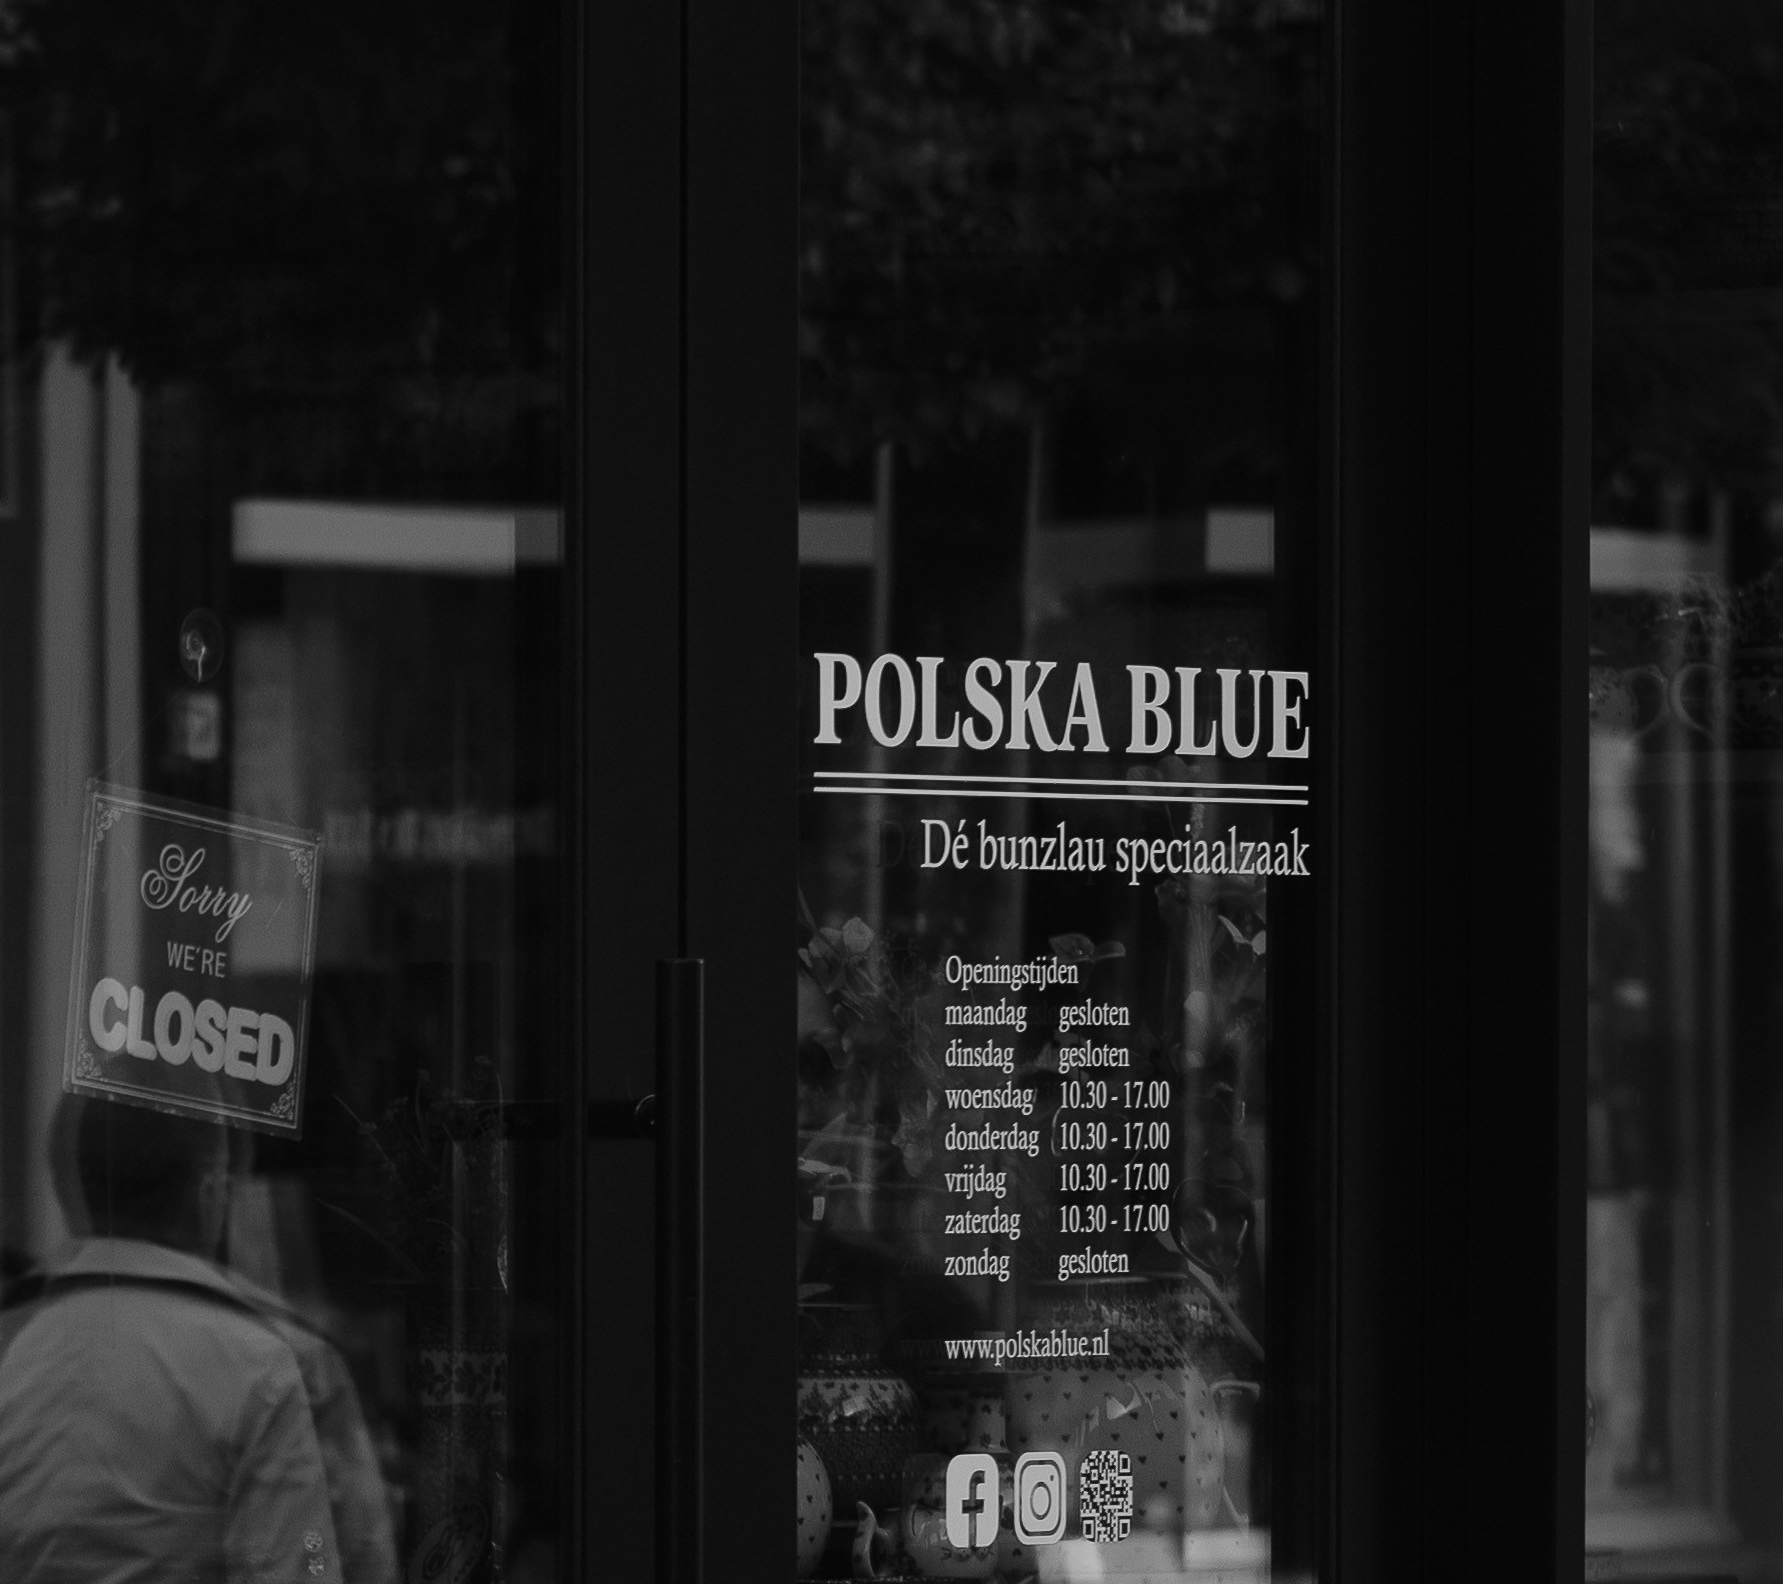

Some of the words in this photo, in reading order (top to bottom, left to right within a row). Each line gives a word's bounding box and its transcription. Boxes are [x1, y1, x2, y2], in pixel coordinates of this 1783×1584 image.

[813, 652, 1110, 753] POLSKA
[1125, 664, 1310, 759] BLUE
[920, 818, 969, 870] Dé
[977, 818, 1107, 872] bunzlau
[1116, 823, 1311, 886] speciaalzaak
[140, 843, 253, 943] Sorry
[167, 941, 228, 978] WE'RE
[945, 955, 1079, 992] Openingstijden
[89, 977, 295, 1086] CLOSED
[944, 997, 1028, 1033] maandag
[1058, 998, 1131, 1033] gesloten
[945, 1038, 1015, 1074] dinsdag
[1058, 1039, 1130, 1075] gesloten
[944, 1080, 1033, 1116] woensdag
[1060, 1080, 1107, 1109] 10.30
[1124, 1080, 1170, 1109] 17.00
[944, 1121, 1040, 1158] donderdag
[1060, 1121, 1107, 1151] 10.30
[1124, 1121, 1170, 1151] 17.00
[944, 1163, 1007, 1200] vrijdag
[1060, 1163, 1107, 1192] 10.30
[1123, 1162, 1170, 1191] 17.00
[944, 1205, 1021, 1241] zaterdag
[1060, 1204, 1107, 1233] 10.30
[1123, 1204, 1170, 1232] 17.00
[944, 1247, 1011, 1283] zondag
[1058, 1245, 1130, 1282] gesloten
[944, 1328, 1110, 1367] www.polskablue.nl
